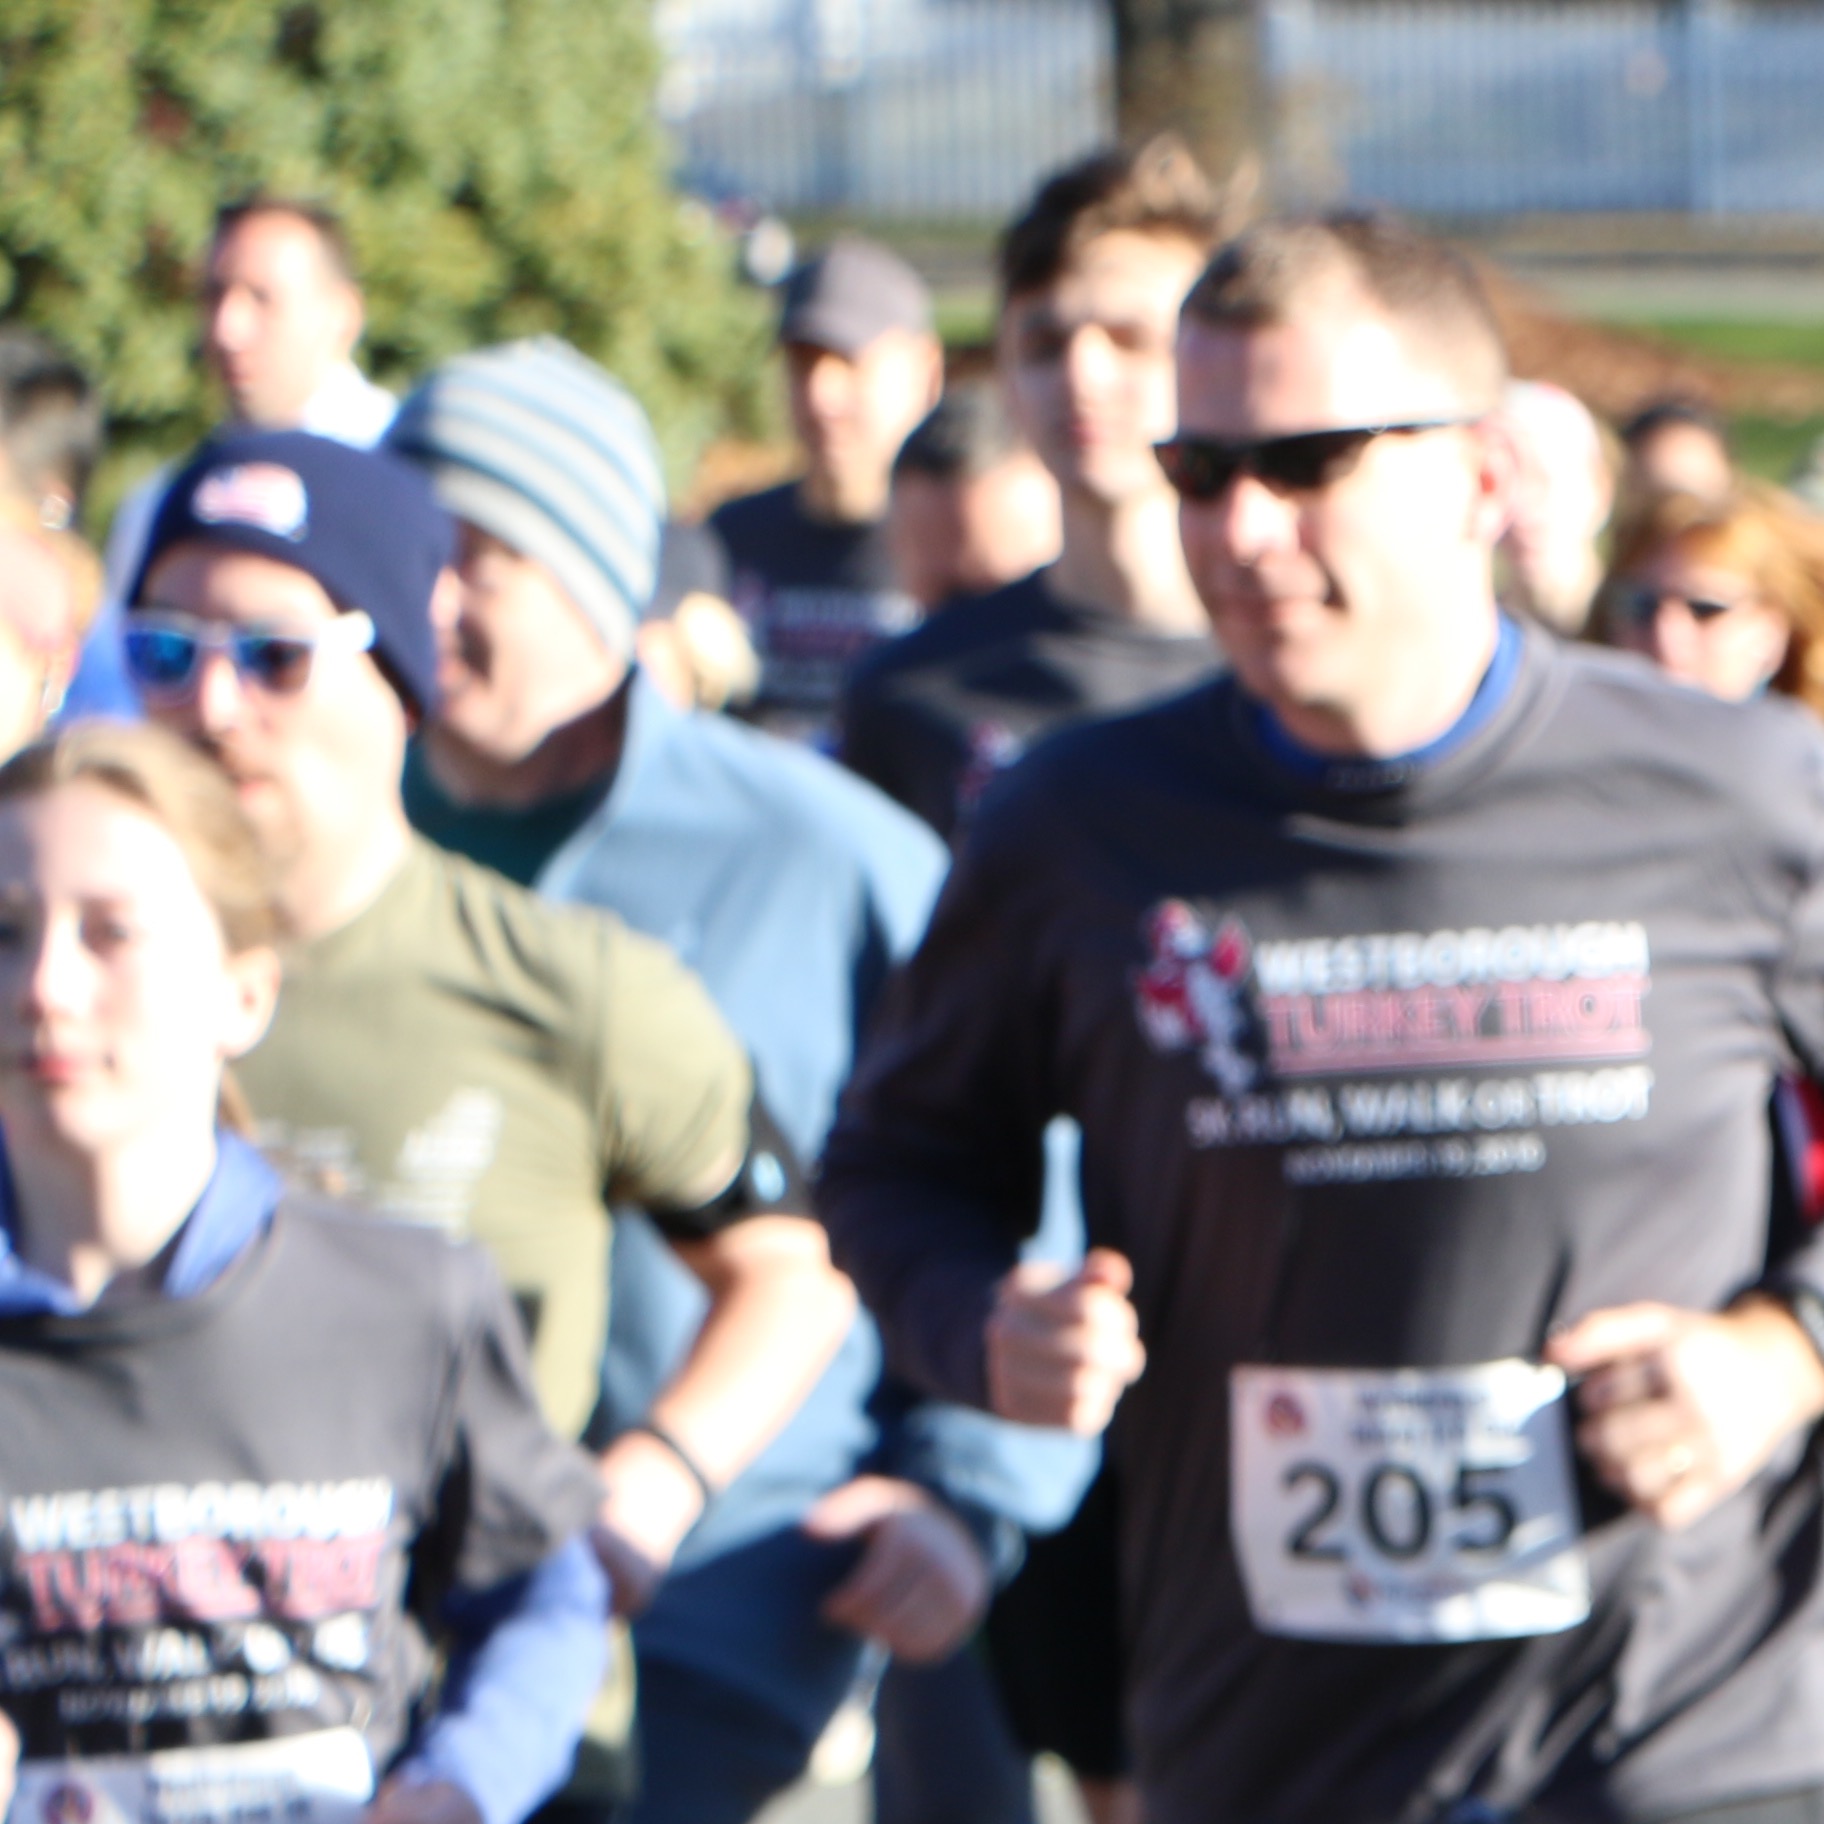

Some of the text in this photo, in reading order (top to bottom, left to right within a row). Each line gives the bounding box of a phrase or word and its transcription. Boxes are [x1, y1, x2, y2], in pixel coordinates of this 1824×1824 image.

[1254, 923, 1650, 996] WESTBOROUGH
[1266, 974, 1652, 1050] TURKEY TROT
[1282, 1460, 1518, 1562] 205
